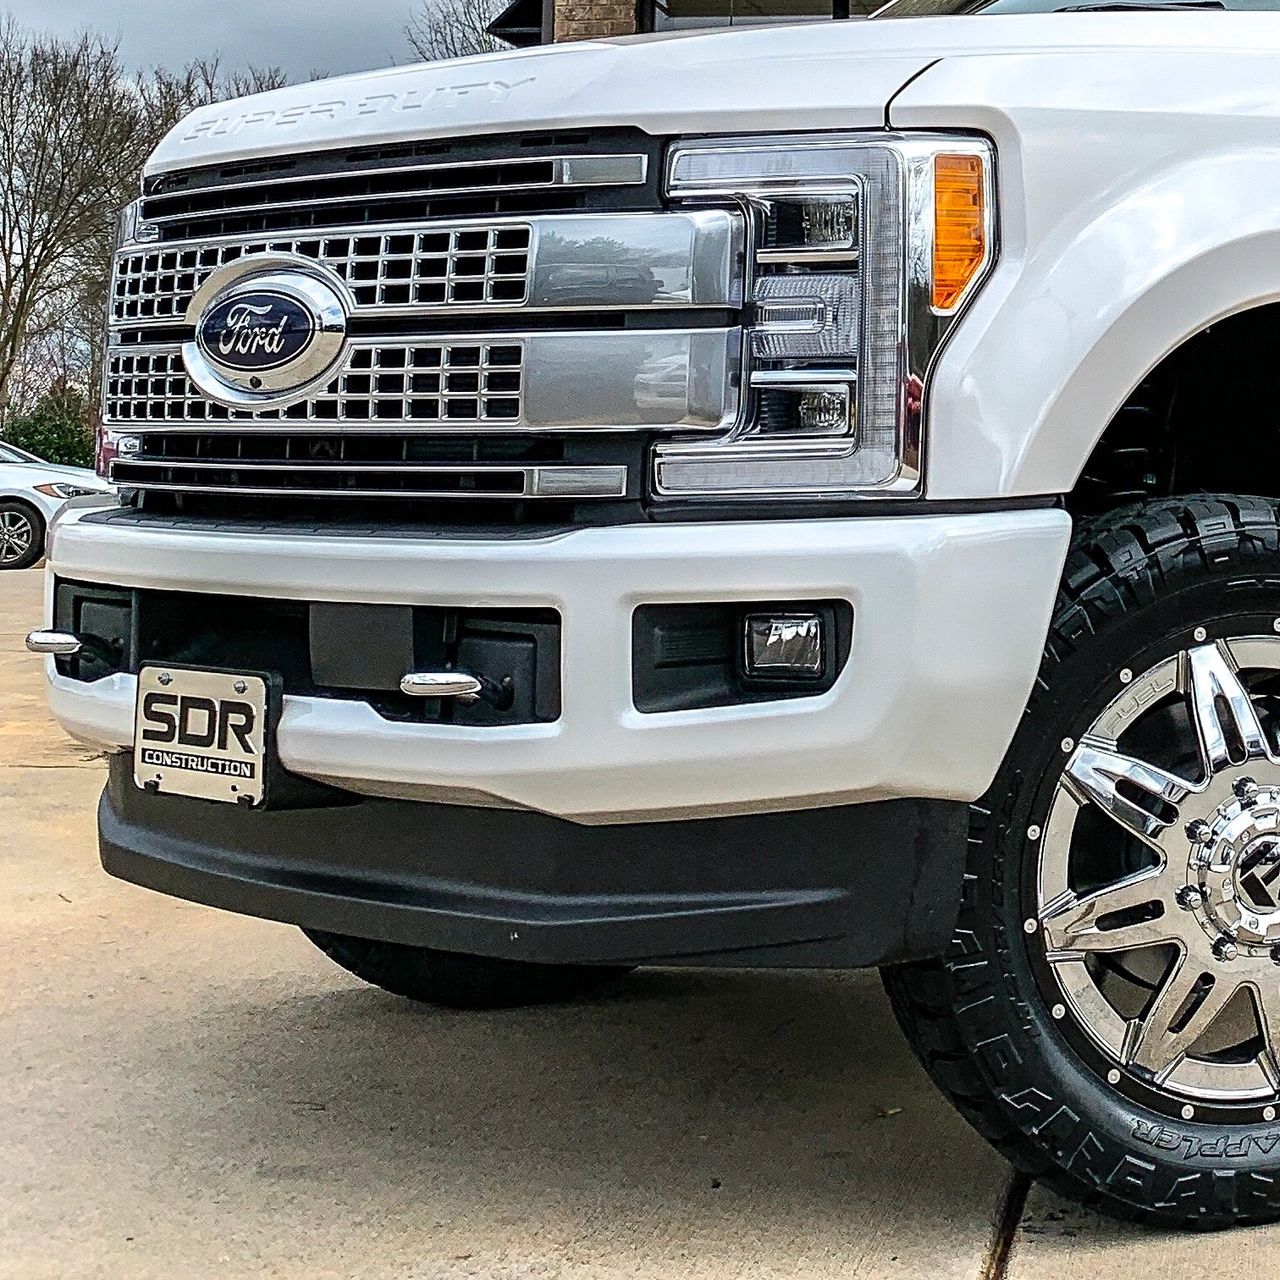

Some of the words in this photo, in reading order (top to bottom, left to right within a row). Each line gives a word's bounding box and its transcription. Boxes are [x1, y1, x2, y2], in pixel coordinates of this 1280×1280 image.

[183, 100, 347, 142] SUPER
[357, 76, 538, 116] DUTY
[218, 303, 288, 355] Ford
[142, 692, 258, 755] SDR
[1104, 677, 1175, 737] FUEL
[144, 750, 252, 778] CONSTRUCTION
